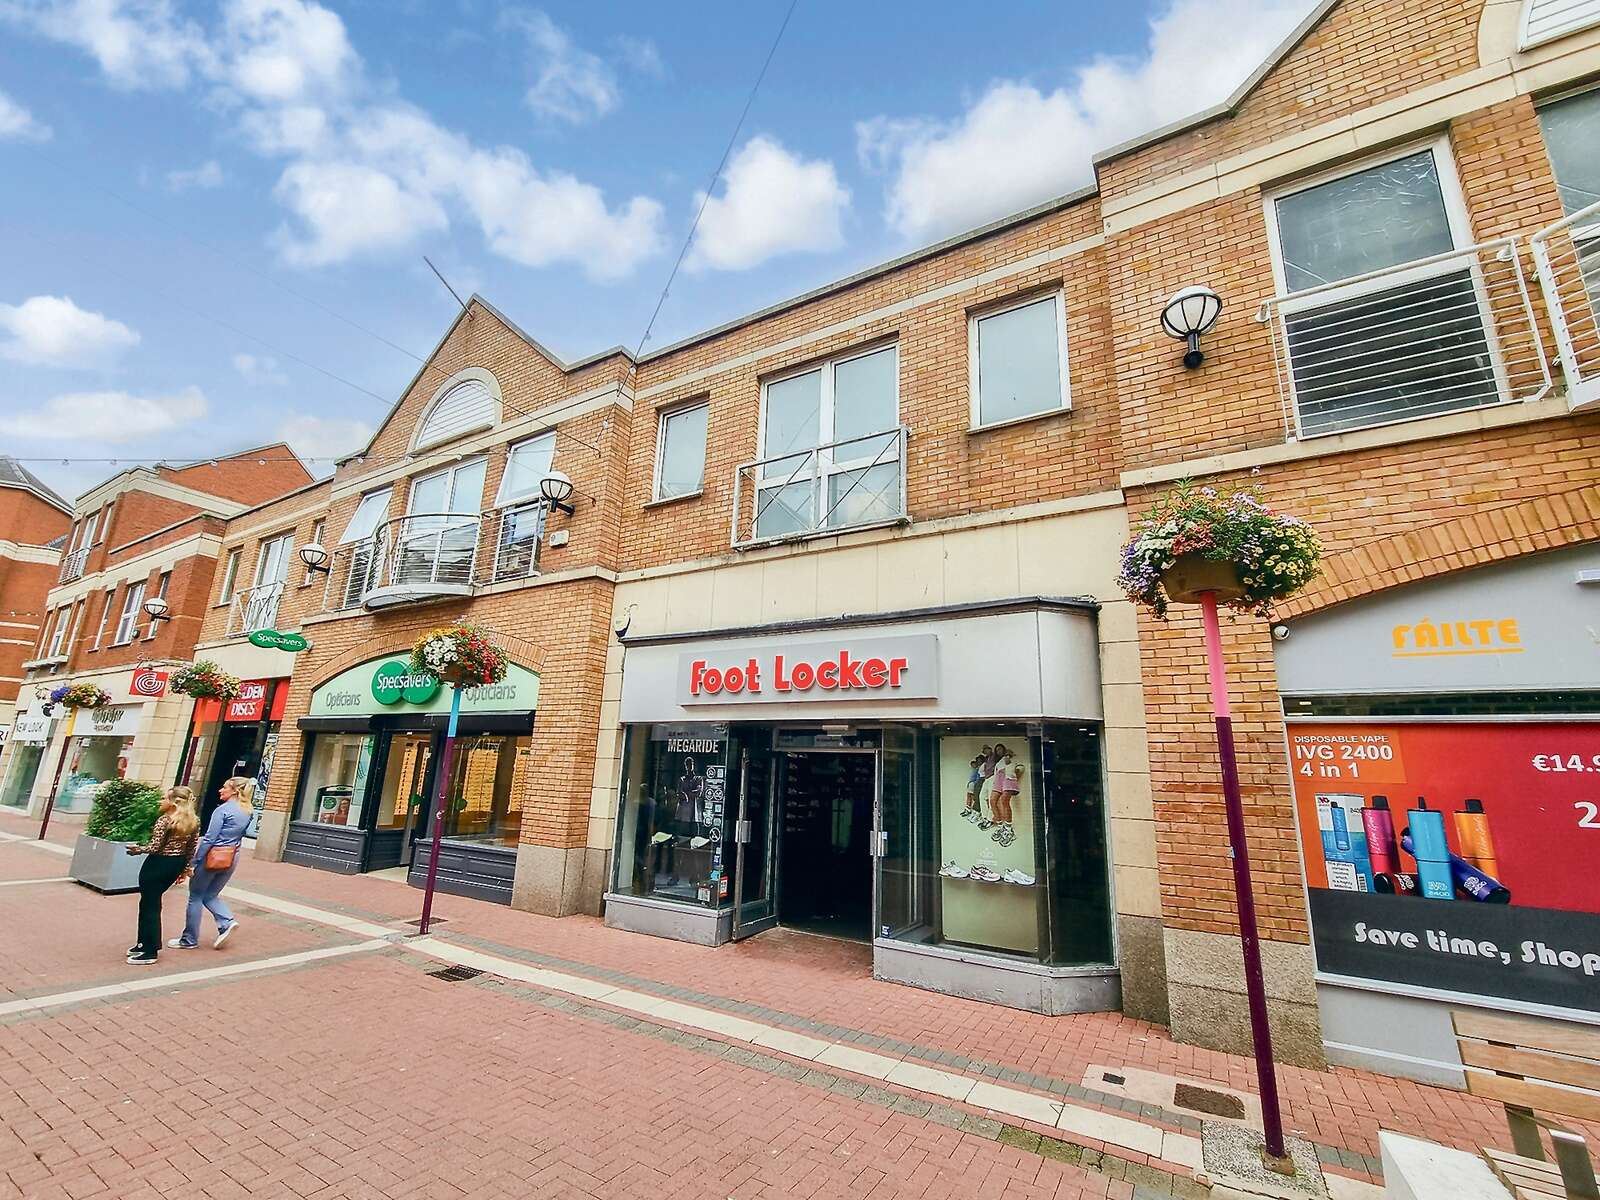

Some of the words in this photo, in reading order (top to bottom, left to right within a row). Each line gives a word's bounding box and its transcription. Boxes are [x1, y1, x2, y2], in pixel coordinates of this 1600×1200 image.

[257, 633, 303, 647] Specsavers
[690, 658, 762, 696] Foot
[773, 648, 909, 692] Locker
[376, 672, 432, 693] Specsavers
[325, 690, 361, 710] Opticians
[466, 684, 516, 704] Opticians
[230, 702, 256, 716] DISCS
[667, 738, 719, 753] MEGARIDE
[1294, 735, 1358, 743] DISPOSABLE
[1360, 735, 1389, 743] VAPE
[1295, 745, 1335, 760] IVG
[1341, 745, 1393, 760] 2400
[1300, 762, 1314, 777] 4
[1320, 762, 1341, 778] in
[1348, 762, 1360, 778] 1
[1354, 922, 1419, 948] Save
[1426, 929, 1511, 965] time,
[1520, 940, 1600, 976] Shop
